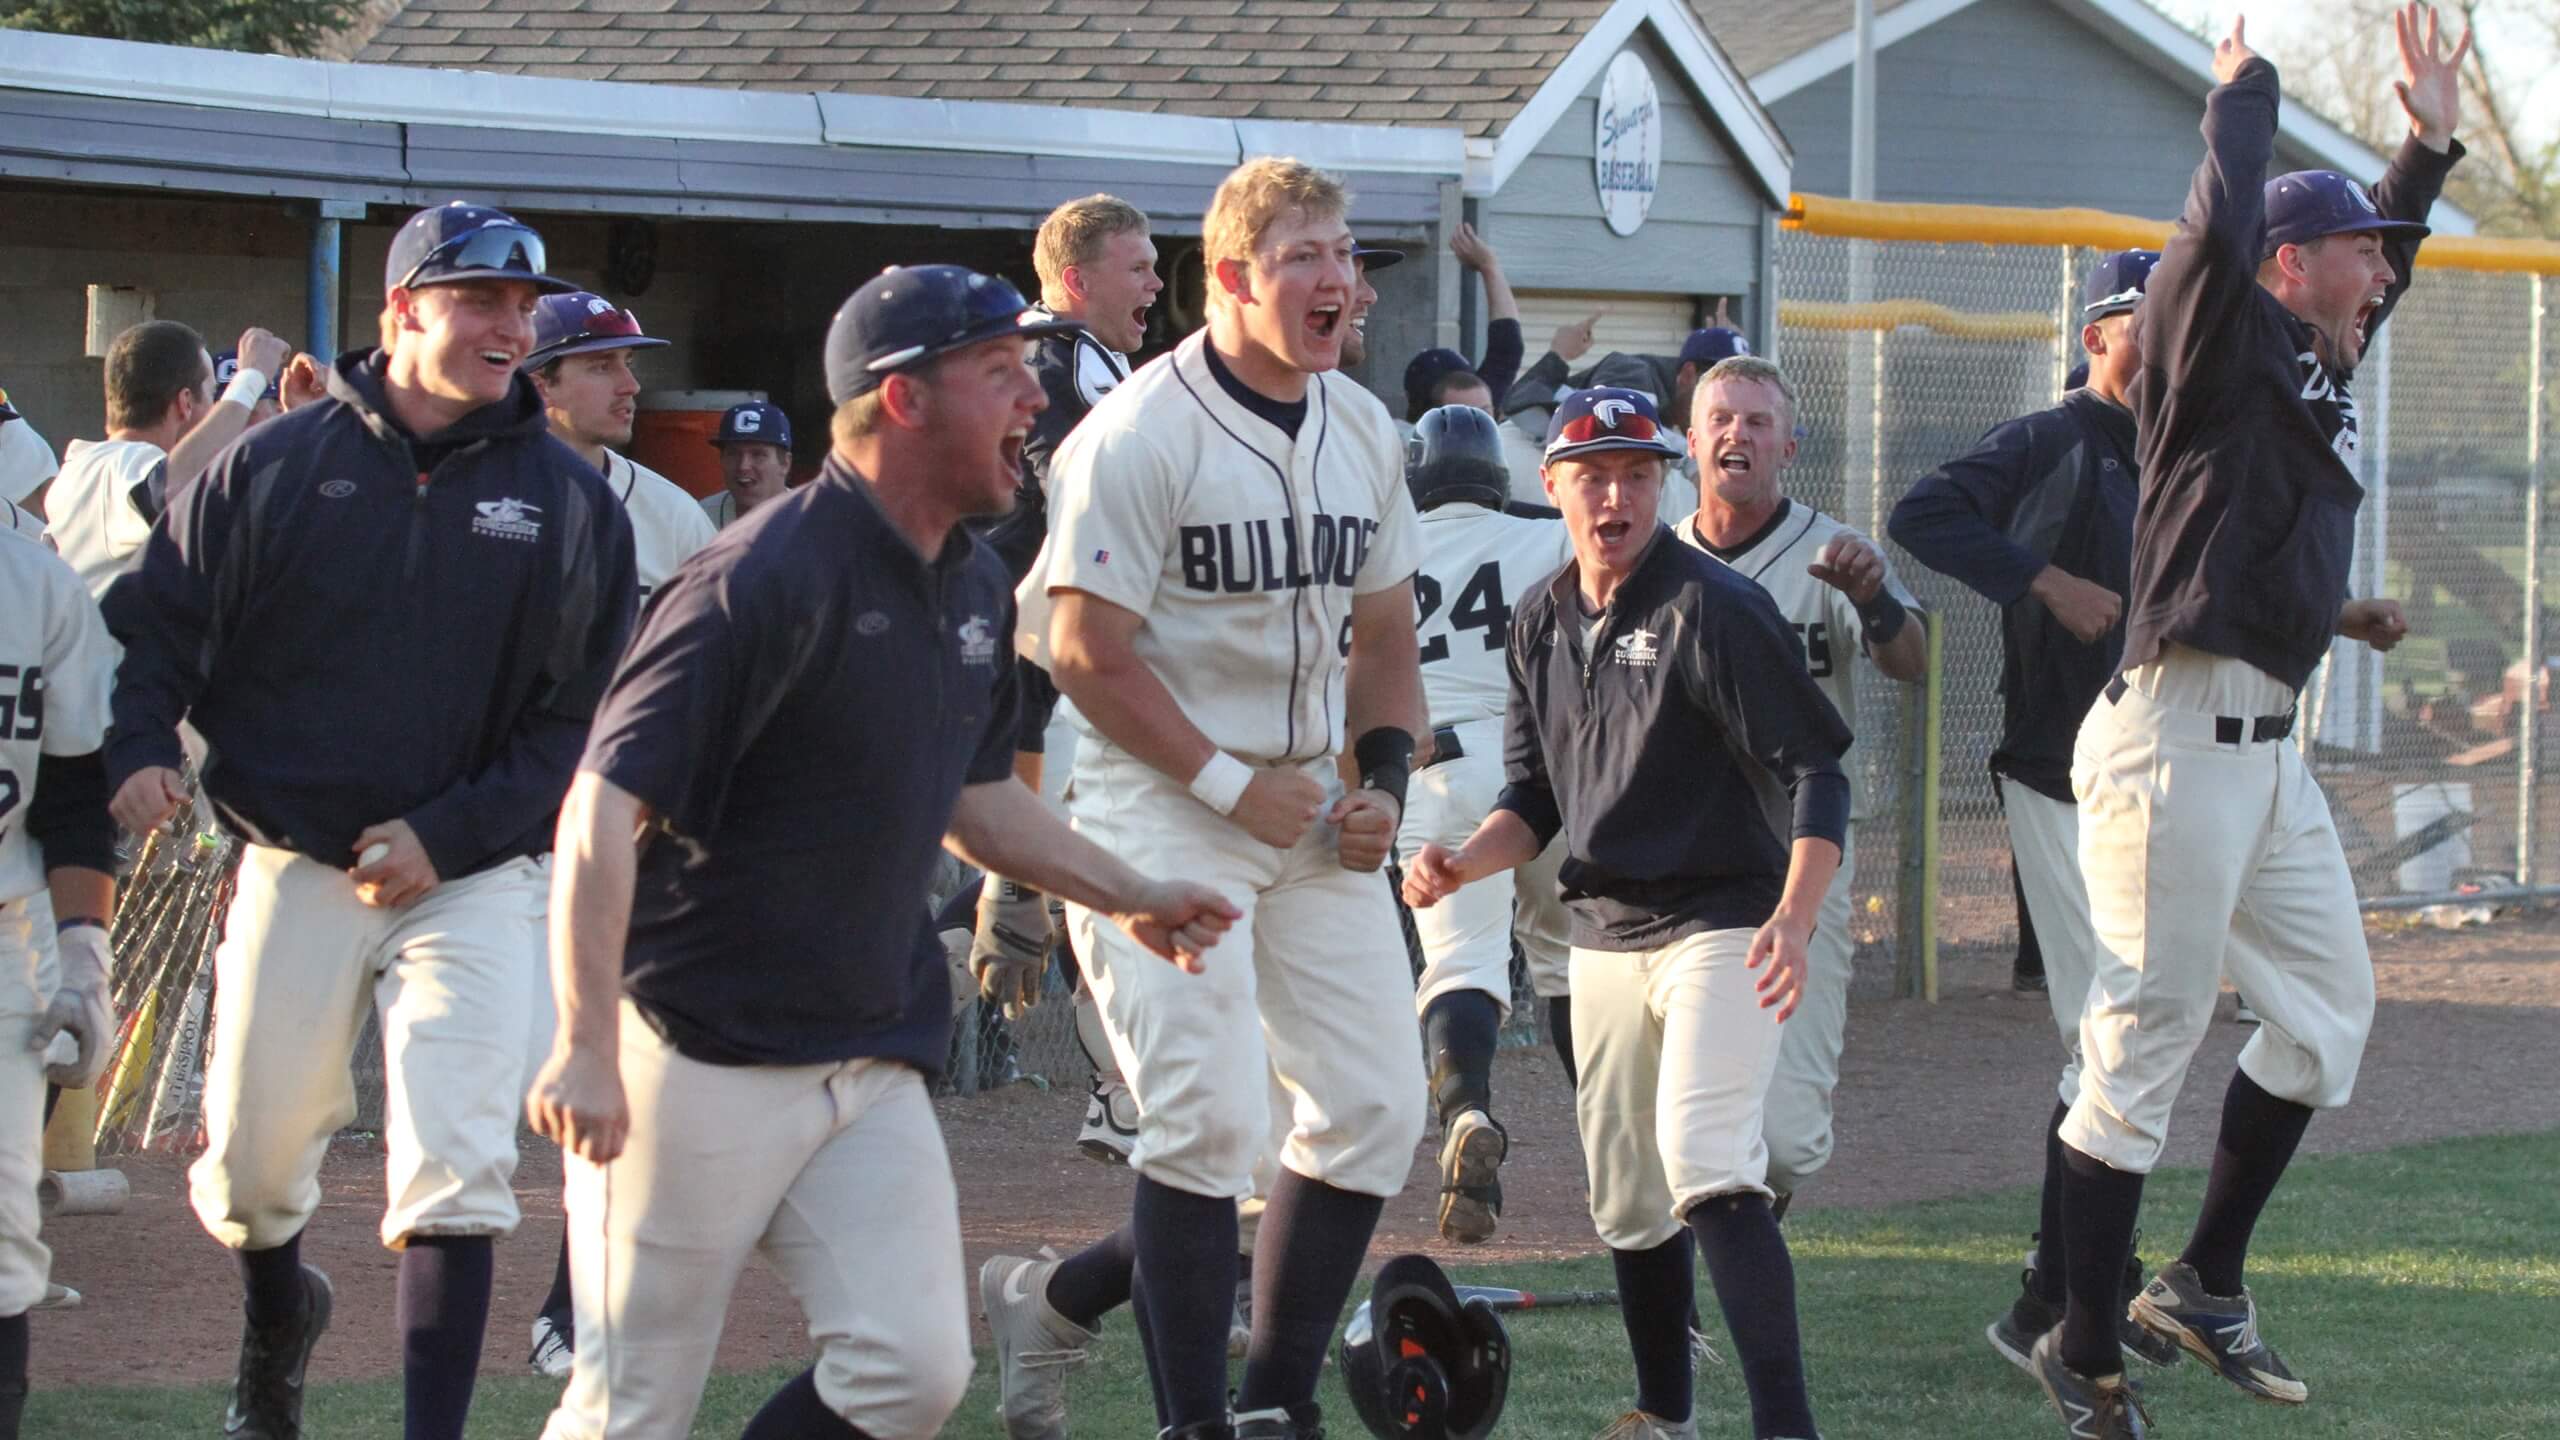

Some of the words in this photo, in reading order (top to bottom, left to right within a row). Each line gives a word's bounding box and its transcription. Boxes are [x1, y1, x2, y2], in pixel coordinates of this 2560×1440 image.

[1601, 161, 1653, 192] BASEBALL
[734, 410, 761, 433] C
[1414, 560, 1513, 665] 24
[1791, 622, 1833, 678] S
